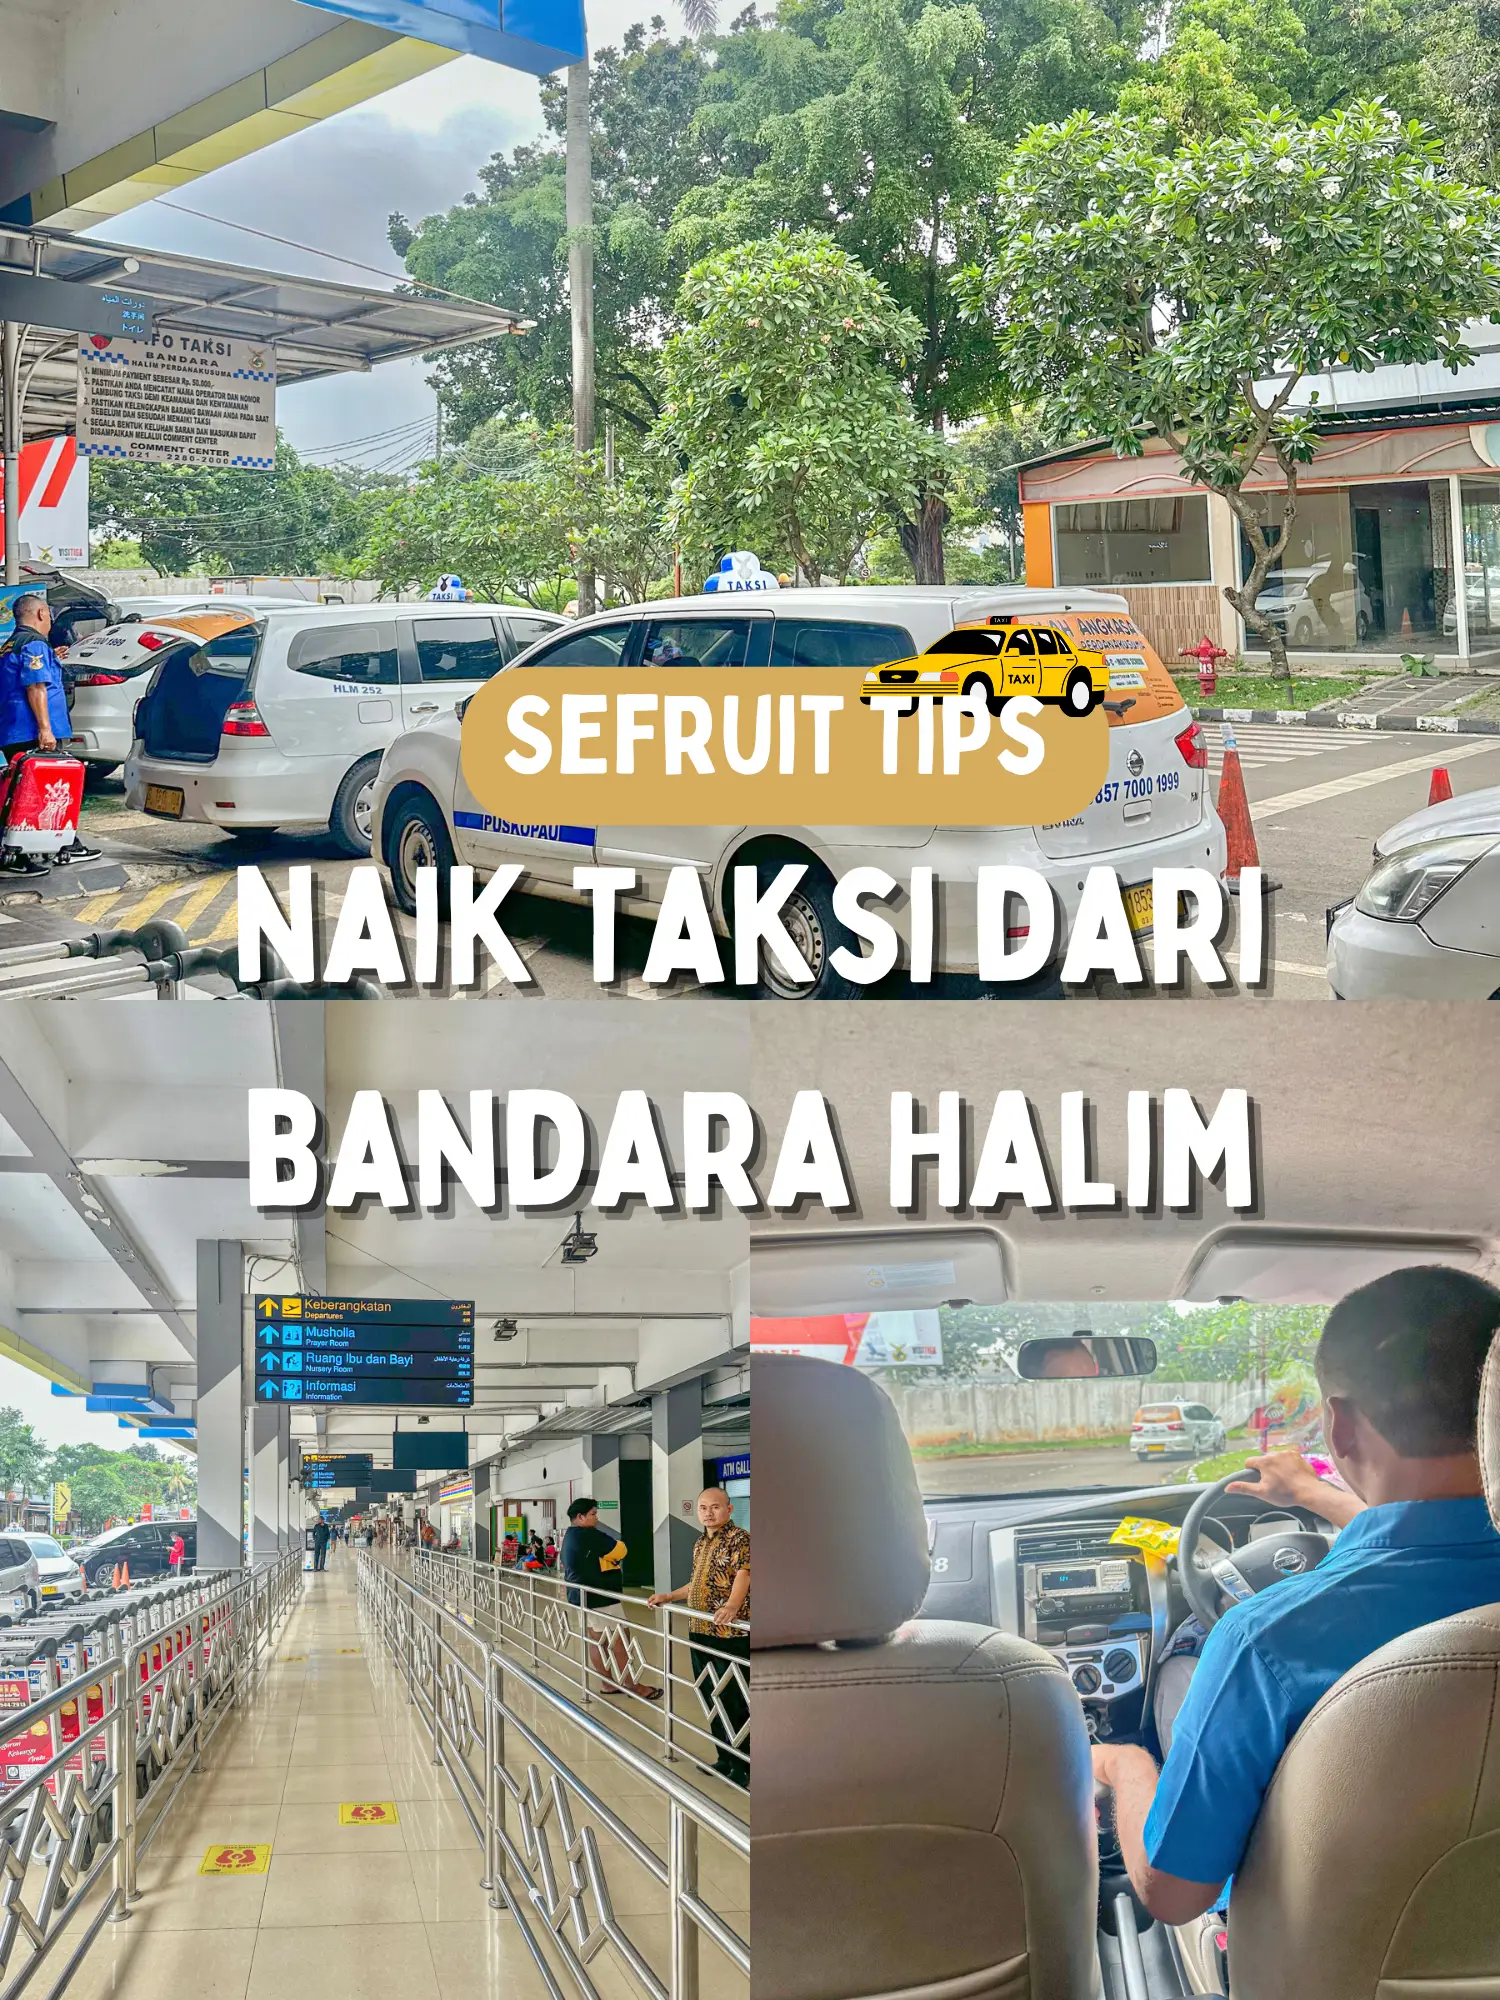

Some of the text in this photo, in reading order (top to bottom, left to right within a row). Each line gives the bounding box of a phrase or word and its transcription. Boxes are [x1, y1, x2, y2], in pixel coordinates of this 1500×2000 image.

[122, 323, 144, 333] トイレ
[180, 338, 232, 357] TAKSI
[146, 351, 219, 368] BANDARA
[91, 367, 121, 377] MINIMUM
[122, 370, 151, 381] PAYMENT
[153, 374, 180, 384] SEBESAR
[181, 377, 191, 386] Rp.
[131, 360, 232, 378] HALIM PERDANAKUSUMA
[91, 378, 123, 389] PASTIKAN
[125, 381, 142, 391] ANDA
[143, 384, 176, 395] MENCATAT
[177, 387, 194, 396] NAMA
[195, 389, 226, 400] OPERATOR
[227, 392, 239, 401] DAN
[240, 395, 260, 404] NOMOR
[91, 387, 249, 411] LAMBUNG TAKSI DEMI KEAMANAN DAN KENYAMANAN
[91, 397, 123, 409] PASTIKAN
[124, 401, 170, 413] KELENGKAPAN
[171, 405, 196, 416] BARANG
[197, 408, 222, 419] BAWAAN
[223, 411, 239, 420] ANDA
[240, 413, 254, 422] PADA
[255, 415, 270, 423] SAAT
[91, 407, 211, 426] SEBELUM DAN SESUDAH MENAIKI TAKSI
[90, 418, 116, 428] SEGALA
[117, 421, 144, 431] BENTUK
[144, 423, 174, 433] KELUHAN
[174, 426, 195, 435] SARAN
[196, 428, 209, 436] DAN
[209, 429, 238, 440] MASUKAN
[238, 431, 257, 440] DAPAT
[90, 427, 218, 445] DISAMPAIKAN MELALUI COMMENT CENTER
[130, 442, 230, 457] COMMENT CENTER
[166, 453, 229, 465] 2280-2000
[58, 548, 84, 557] VISITIGA
[727, 580, 767, 592] TAKSI
[1075, 617, 1138, 637] ANGKASA
[333, 684, 383, 695] HLM 252
[1089, 771, 1179, 806] 857 7000 1999
[483, 814, 559, 841] PUSKOPAU
[304, 1299, 392, 1314] Keberangkatan
[304, 1312, 344, 1320] Departures
[305, 1326, 356, 1339] Musholla
[305, 1339, 350, 1348] Prayer Room
[305, 1352, 414, 1368] Ruang Ibu dan Bayi
[305, 1365, 354, 1374] Nursery Room
[305, 1381, 357, 1393] Informasi
[305, 1393, 343, 1401] Information
[722, 1459, 751, 1478] ATM GALL
